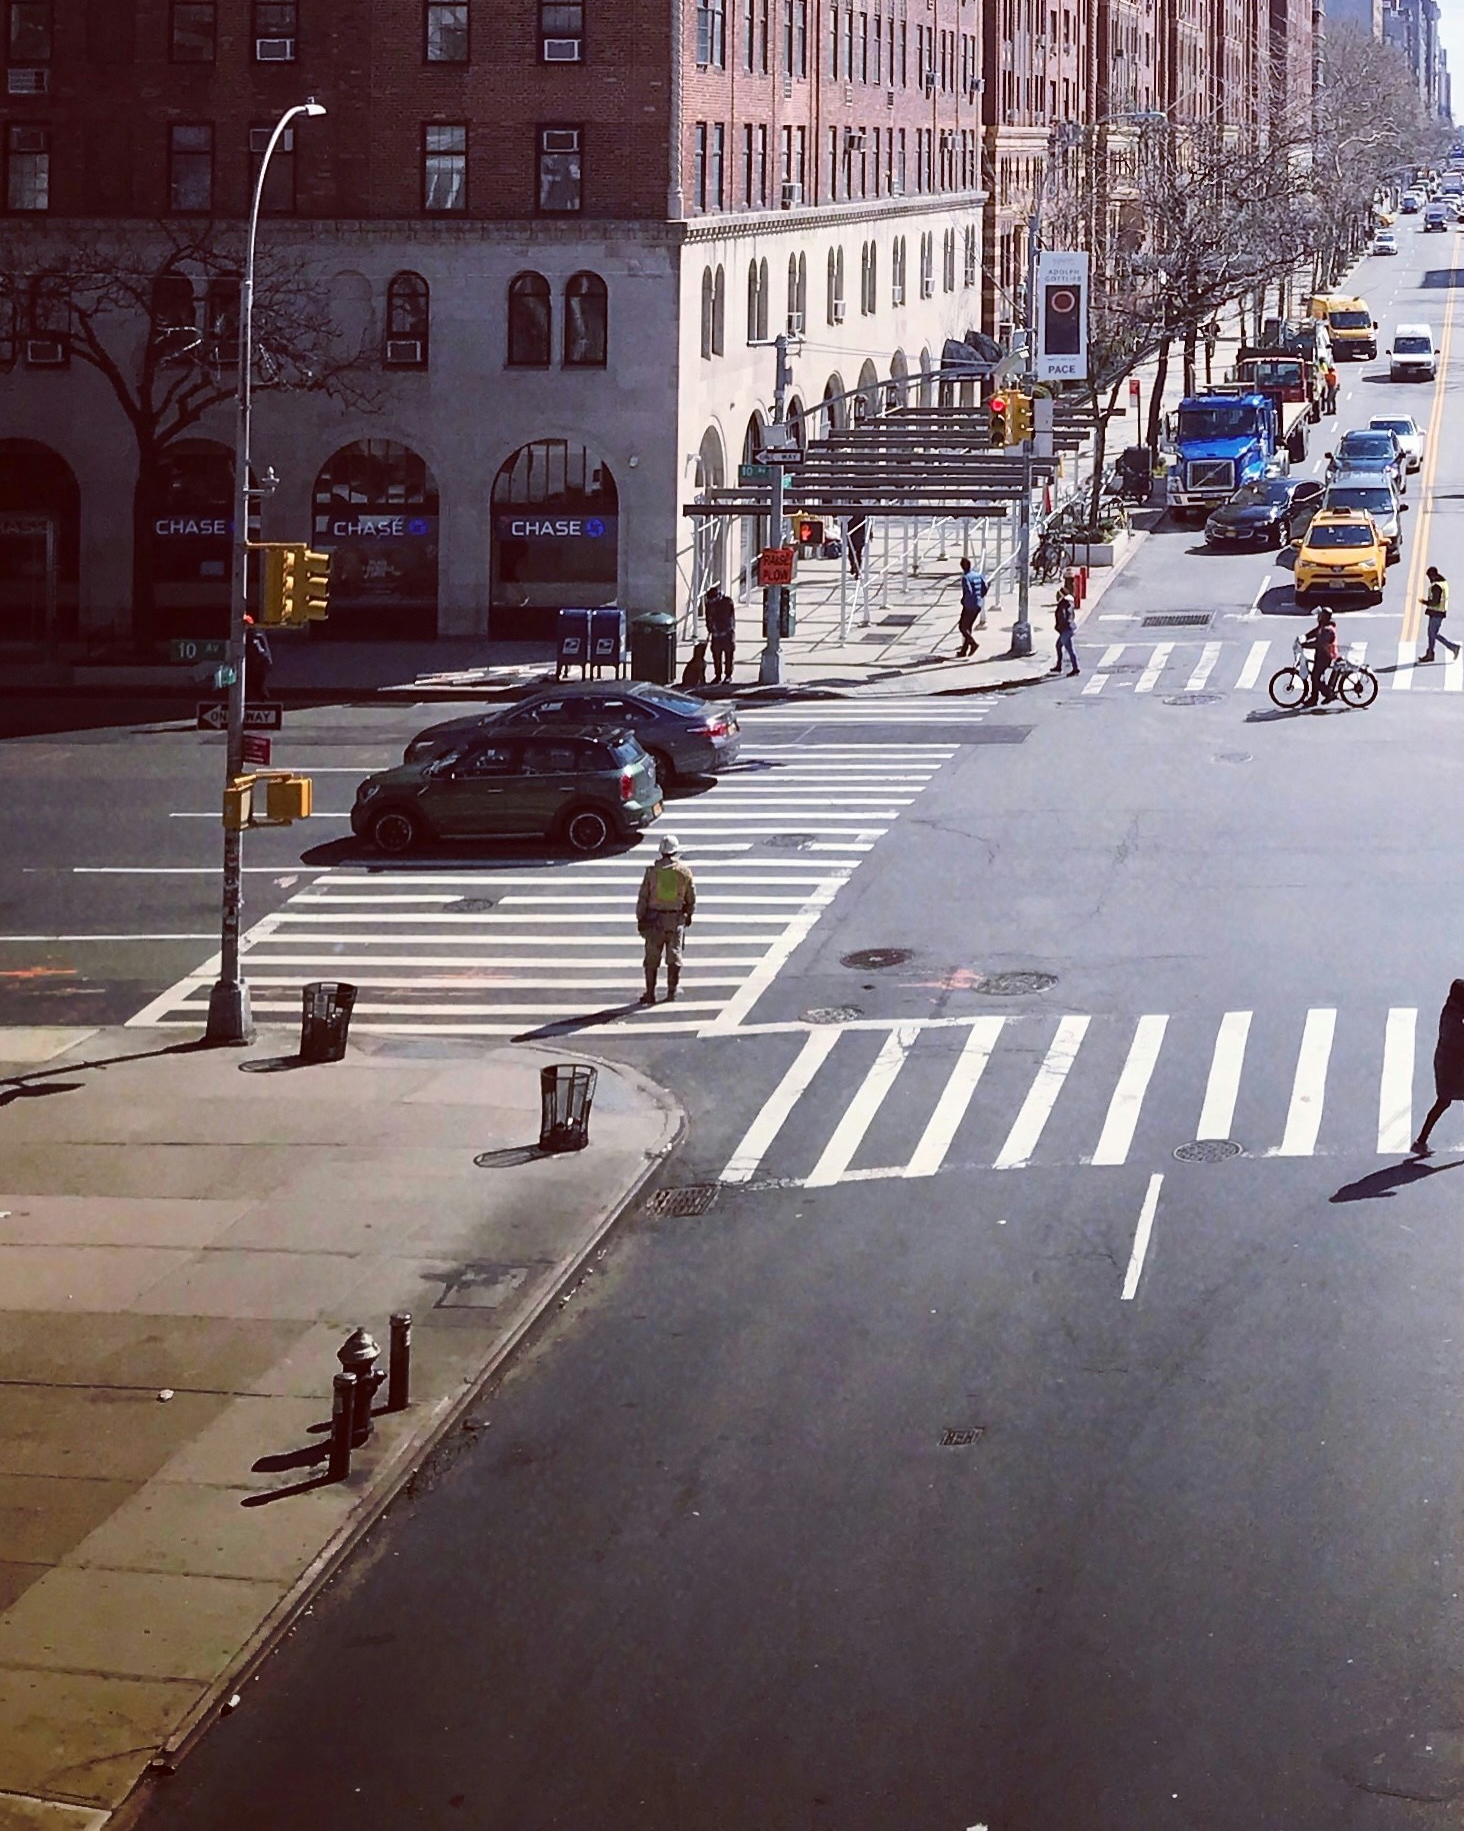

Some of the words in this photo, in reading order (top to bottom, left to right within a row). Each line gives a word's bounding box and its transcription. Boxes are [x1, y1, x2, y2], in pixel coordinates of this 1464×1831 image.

[1048, 365, 1076, 374] PACE
[742, 466, 753, 477] 10
[155, 520, 226, 535] CHASE
[333, 521, 405, 536] CHASE
[511, 521, 582, 536] CHASE
[178, 642, 197, 659] 10
[210, 710, 228, 722] ON
